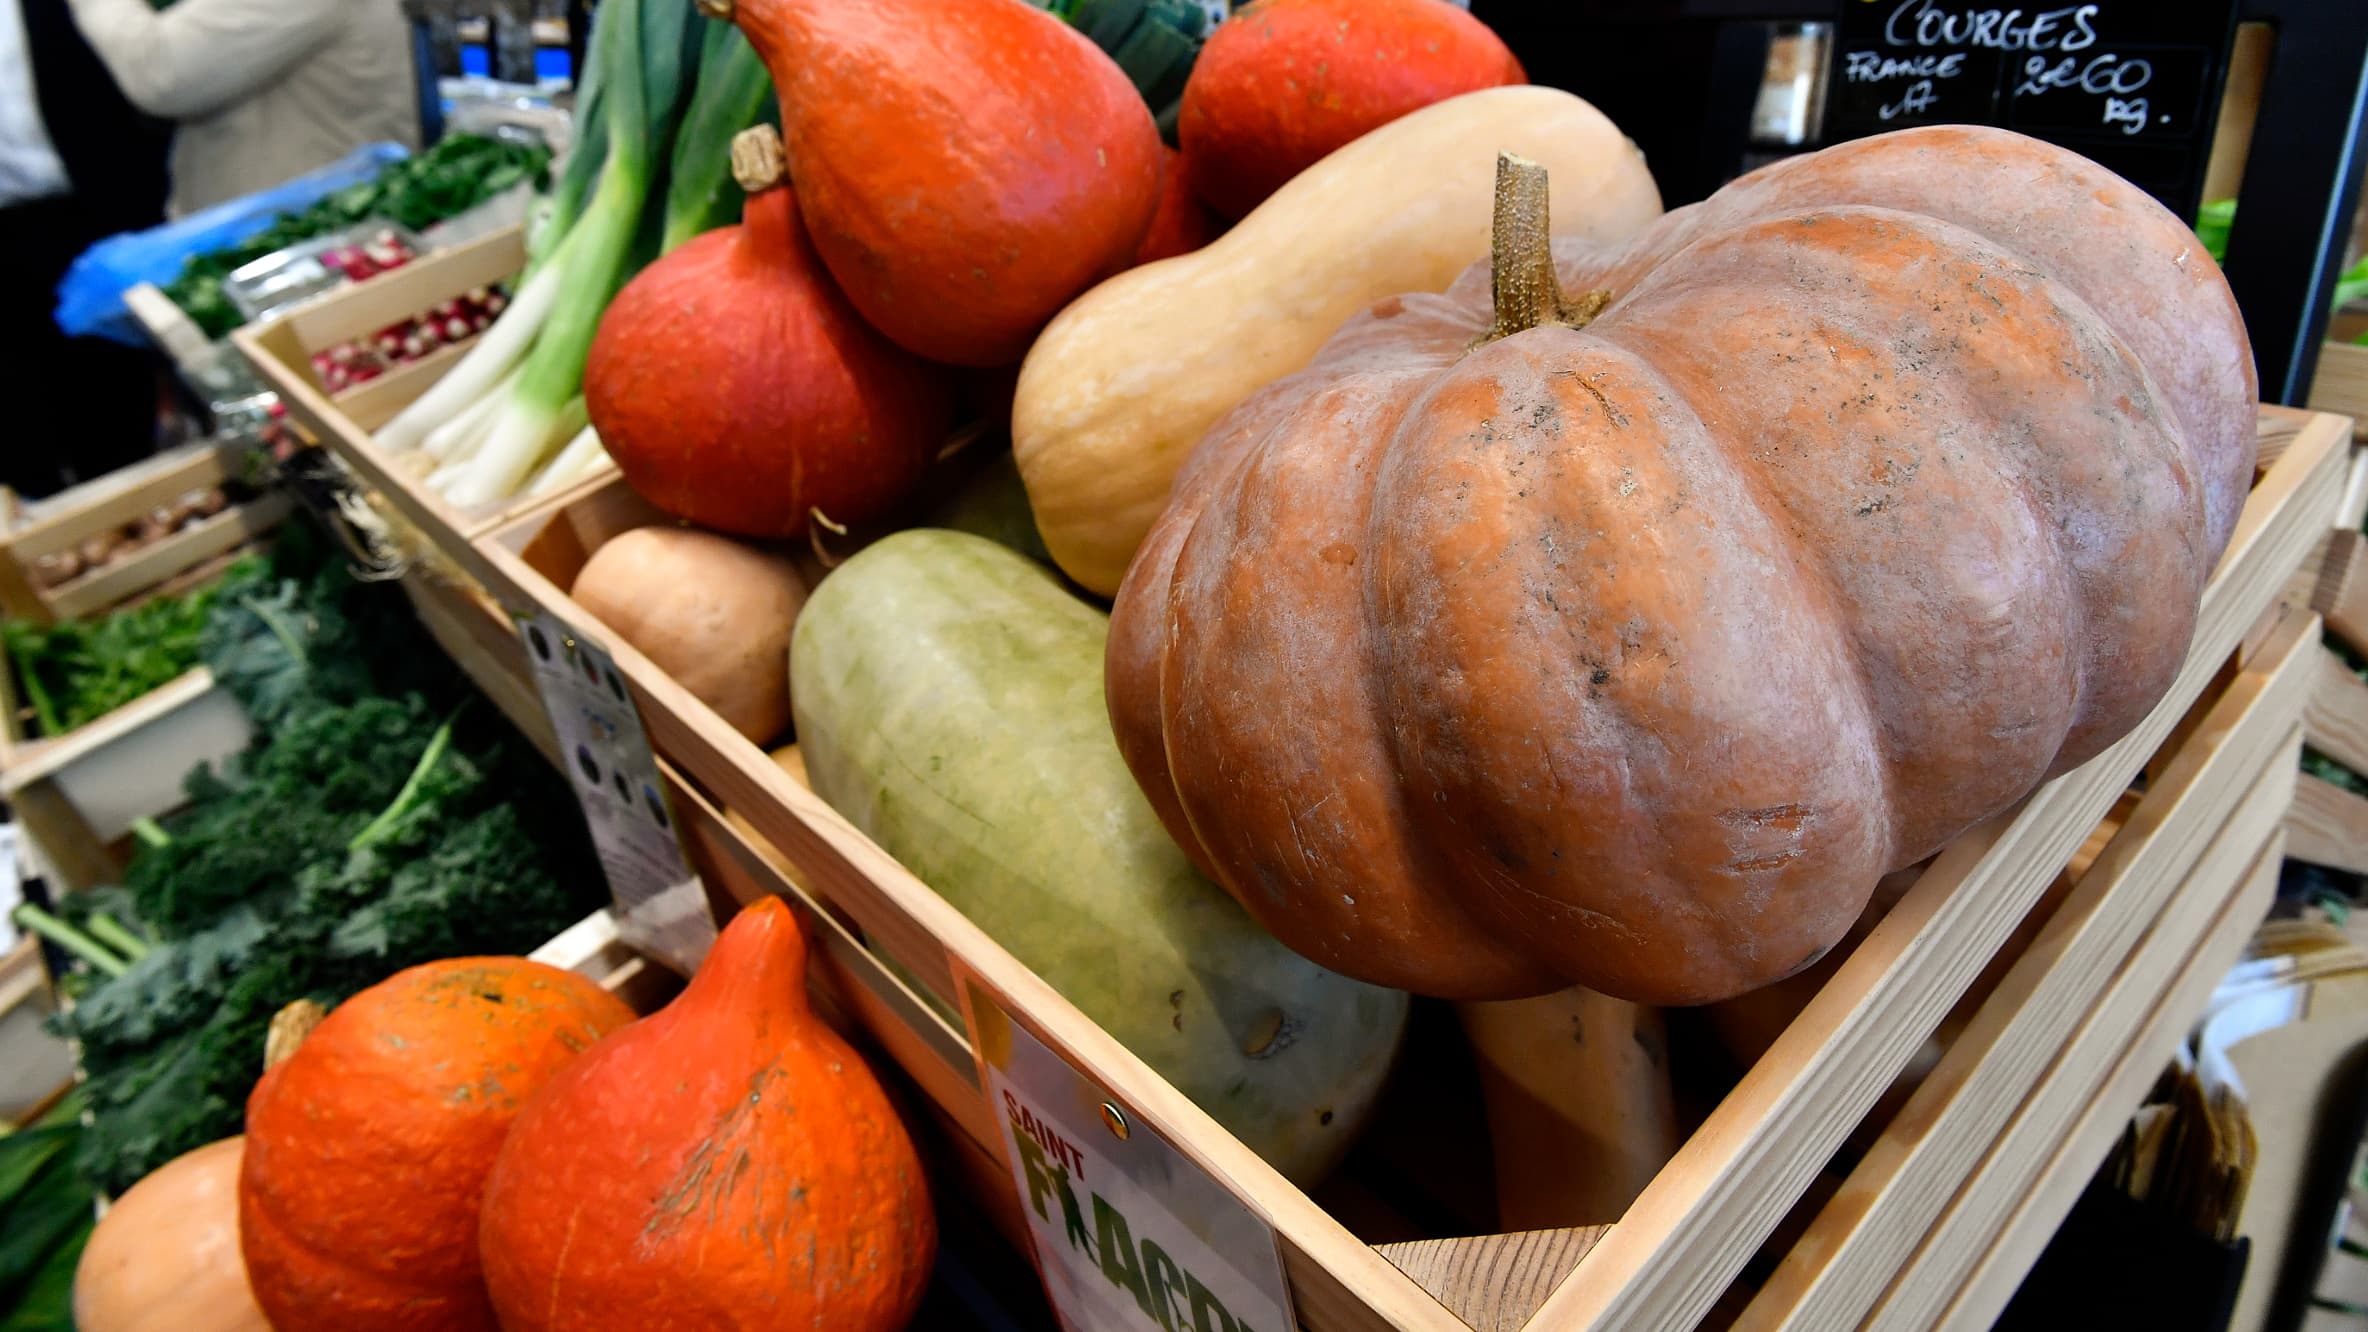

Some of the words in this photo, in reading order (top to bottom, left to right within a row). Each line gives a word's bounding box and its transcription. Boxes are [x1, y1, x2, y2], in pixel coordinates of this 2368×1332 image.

[1885, 0, 2099, 51] COURGES
[1845, 50, 1967, 82] FRANCE
[1002, 1088, 1085, 1183] SAINT
